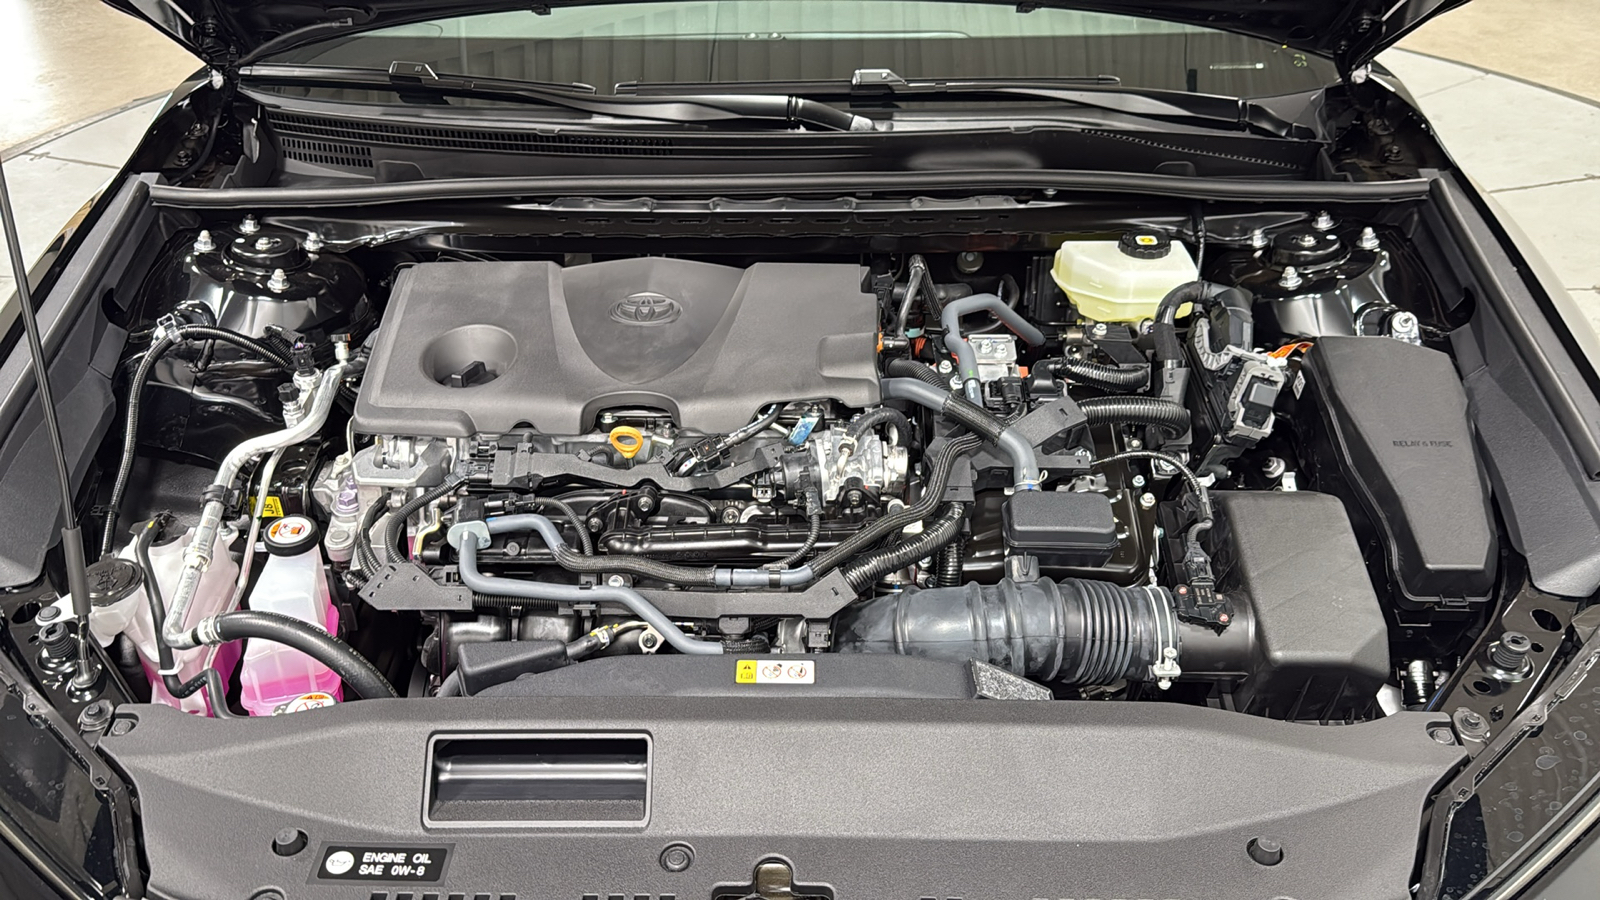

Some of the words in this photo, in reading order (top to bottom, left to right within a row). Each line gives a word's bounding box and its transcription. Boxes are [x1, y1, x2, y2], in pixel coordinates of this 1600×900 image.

[362, 852, 407, 863] ENGINE
[412, 853, 432, 864] OIL
[358, 864, 385, 875] SAE
[390, 865, 426, 876] 0W-8
